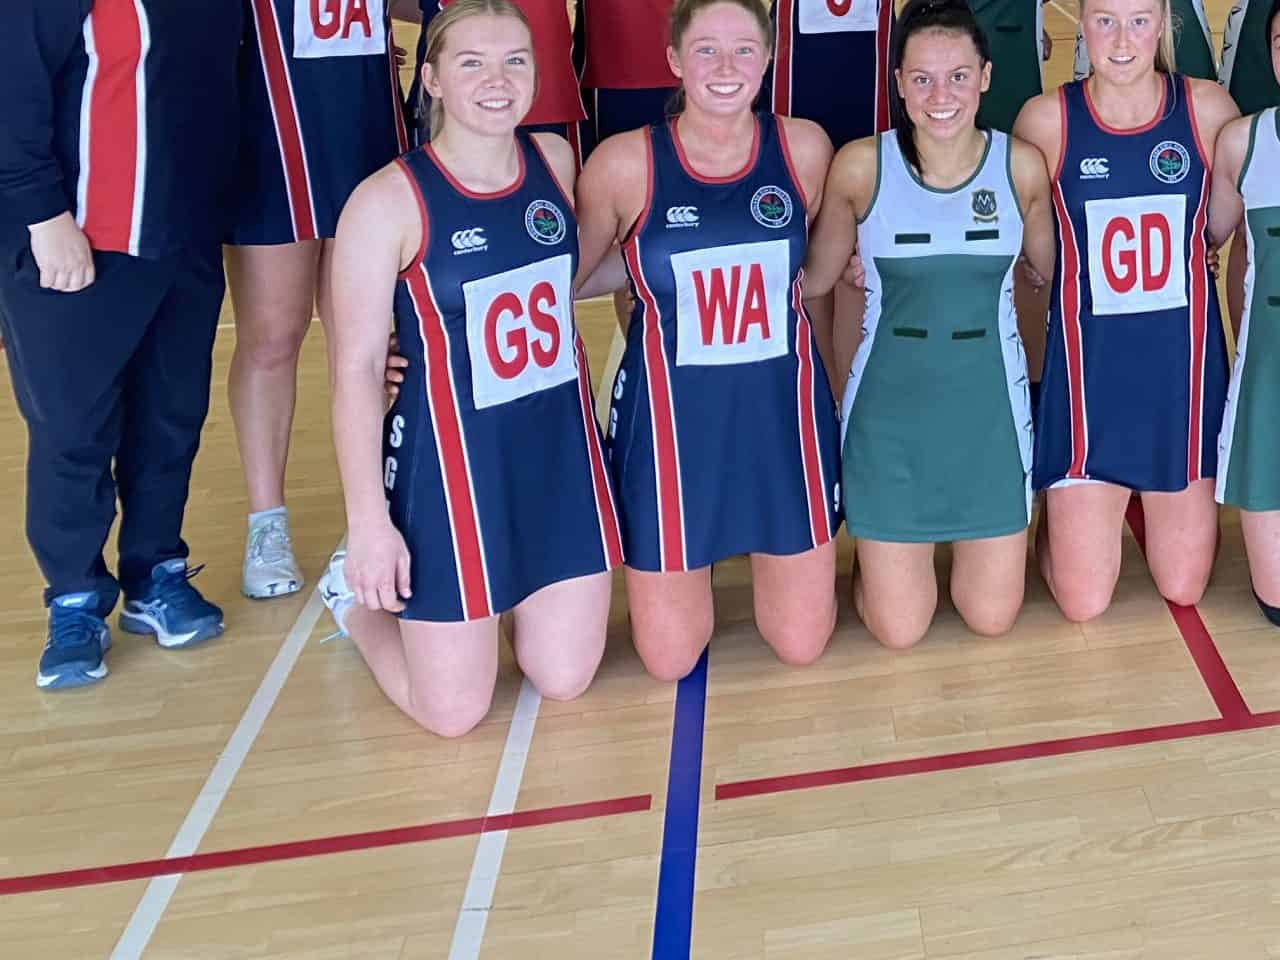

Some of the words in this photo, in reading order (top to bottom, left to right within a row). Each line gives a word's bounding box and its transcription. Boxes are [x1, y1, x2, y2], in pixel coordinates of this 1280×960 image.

[1102, 214, 1172, 292] GD
[486, 283, 560, 378] GS
[695, 265, 770, 344] WA
